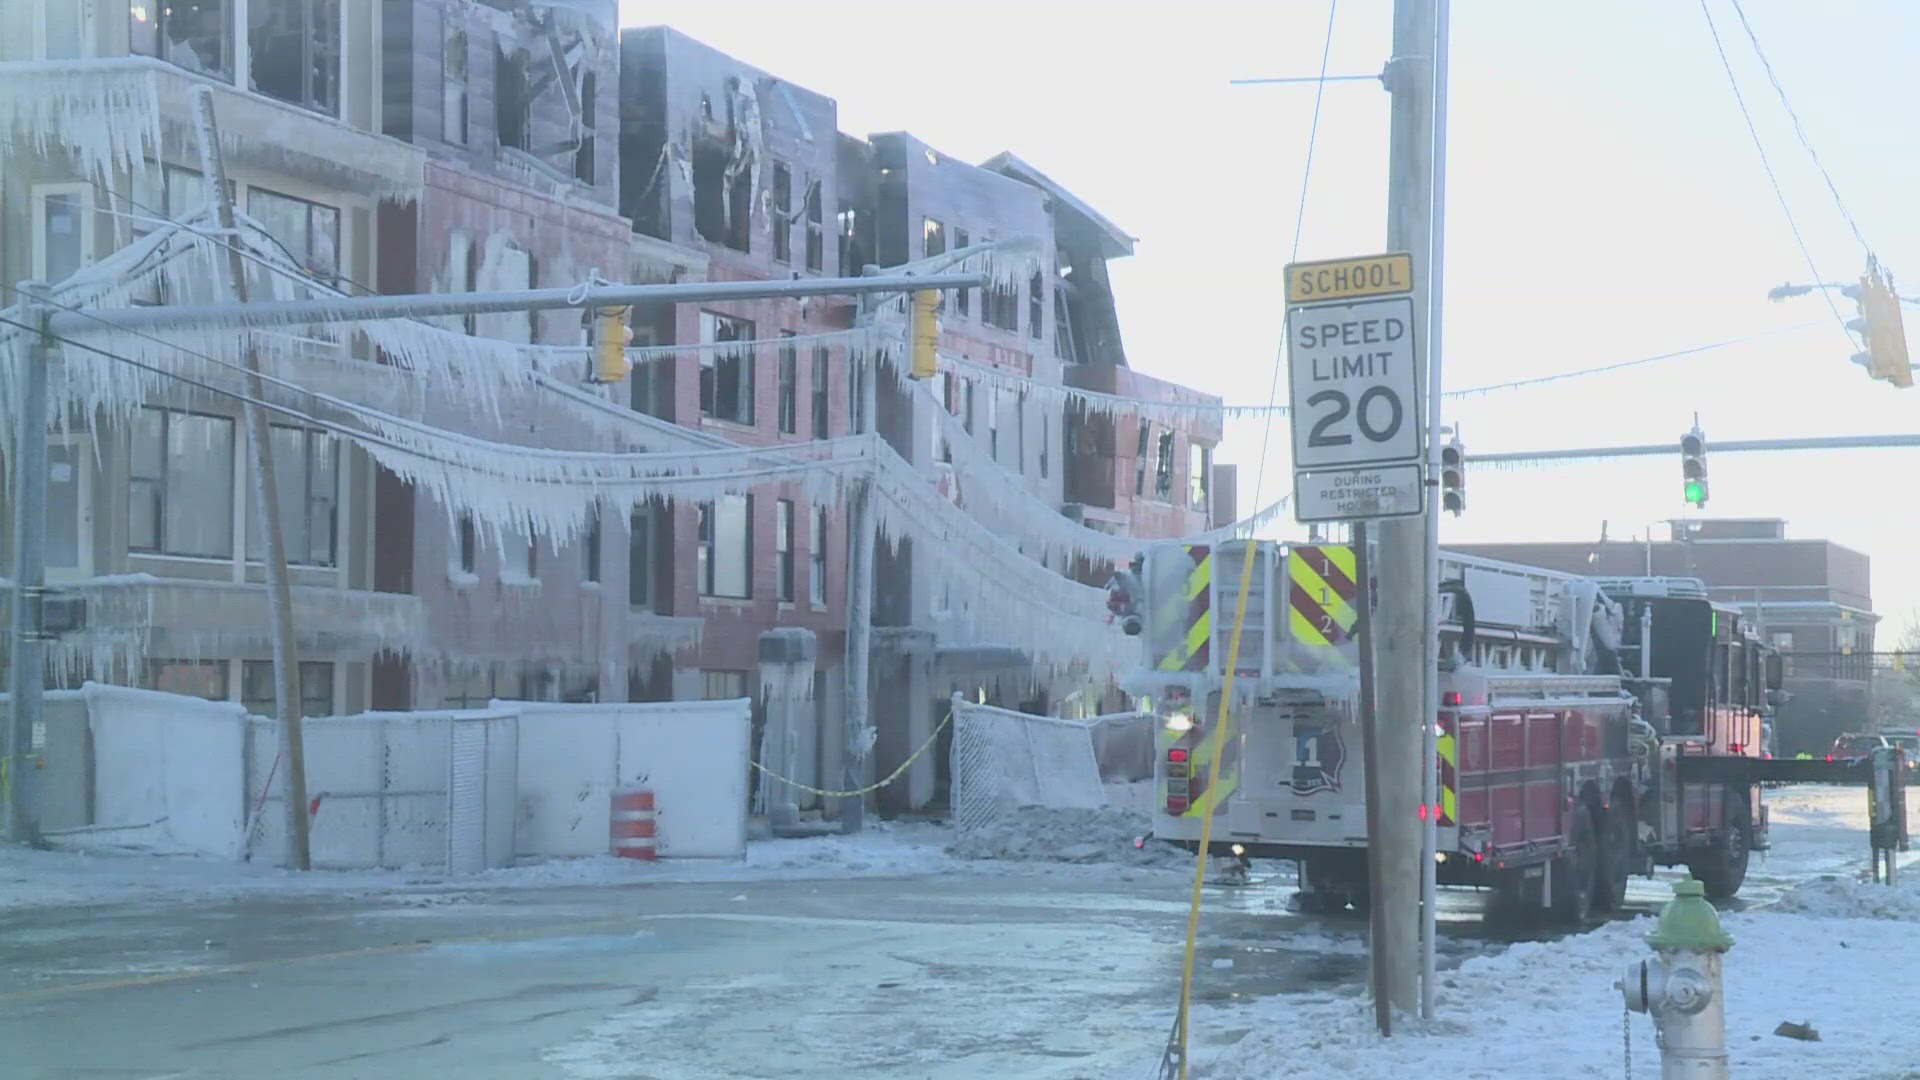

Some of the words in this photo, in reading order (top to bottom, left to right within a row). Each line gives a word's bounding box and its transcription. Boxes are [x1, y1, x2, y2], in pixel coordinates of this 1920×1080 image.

[1301, 264, 1400, 295] SCHOOL
[1299, 319, 1404, 349] SPEED
[1312, 352, 1393, 381] LIMIT
[1306, 386, 1403, 448] 20
[1319, 486, 1397, 500] RESTRICTED
[1334, 474, 1381, 487] DURING
